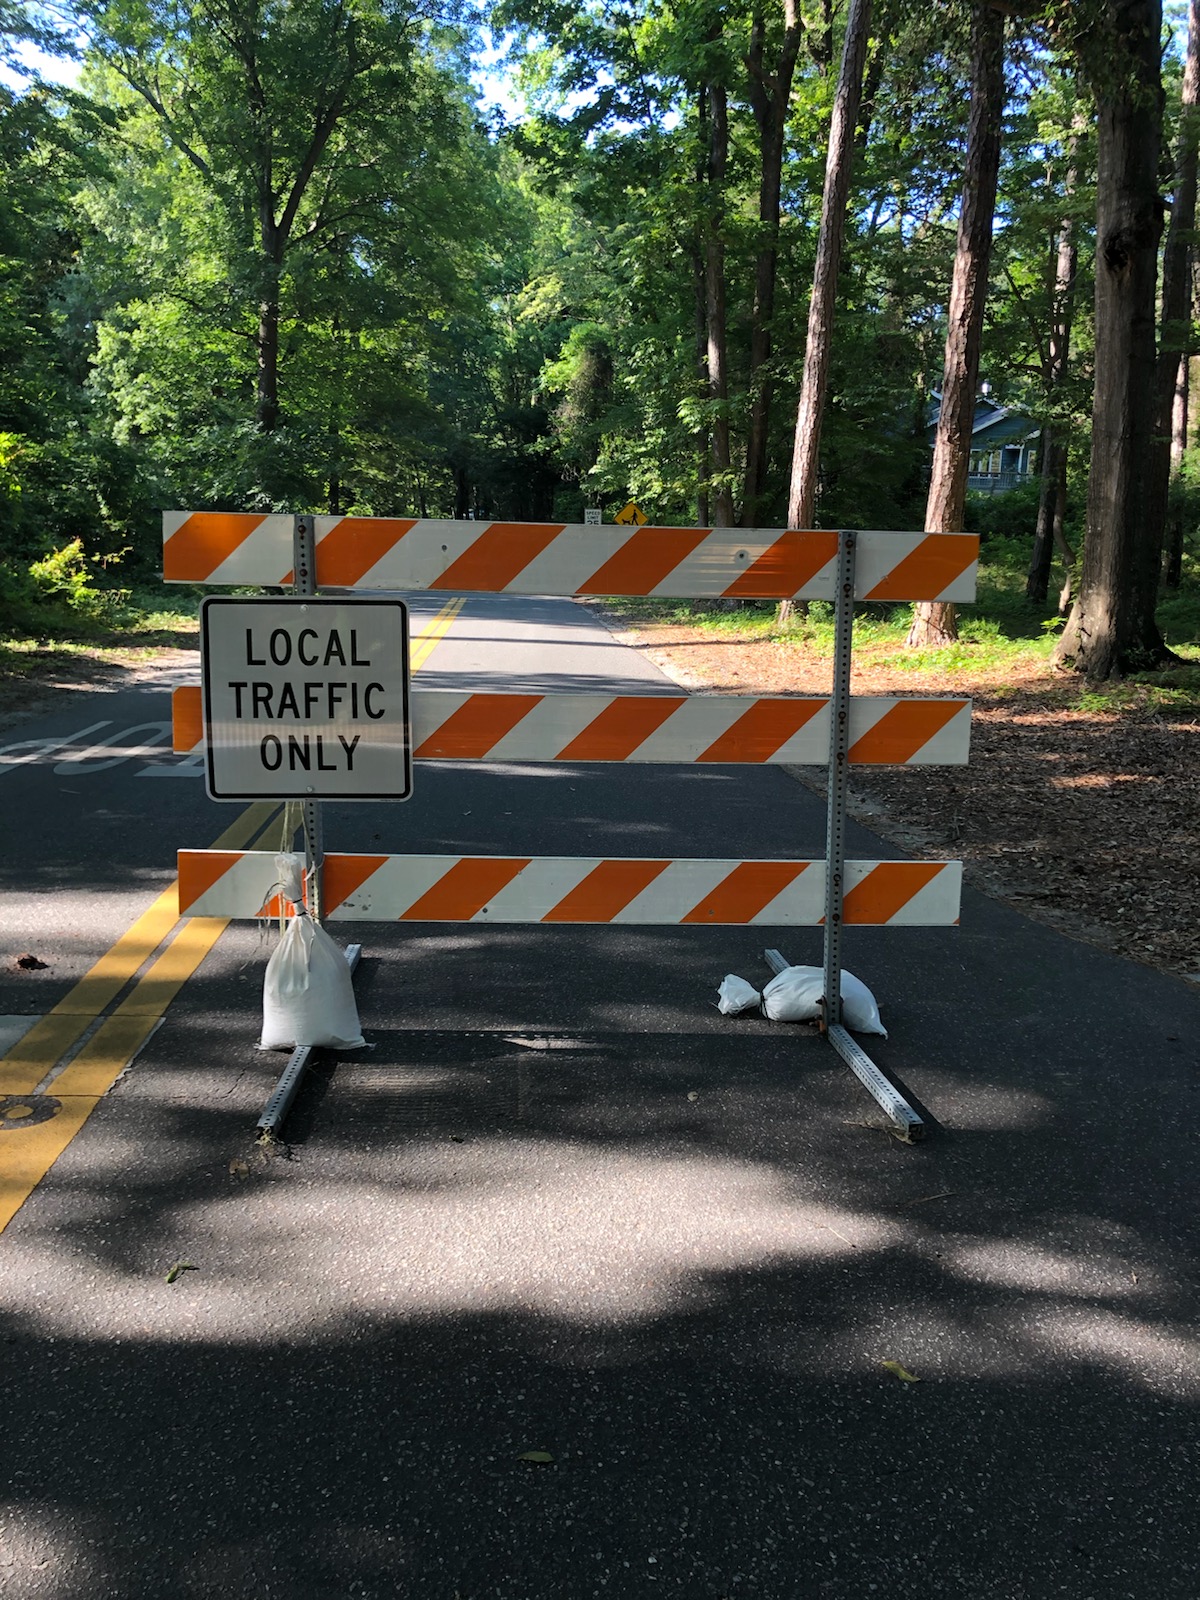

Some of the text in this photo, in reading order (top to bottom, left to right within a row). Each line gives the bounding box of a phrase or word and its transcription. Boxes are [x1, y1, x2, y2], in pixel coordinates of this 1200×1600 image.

[245, 628, 371, 667] LOCAL
[228, 681, 386, 720] TRAFFIC
[260, 734, 361, 771] ONLY
